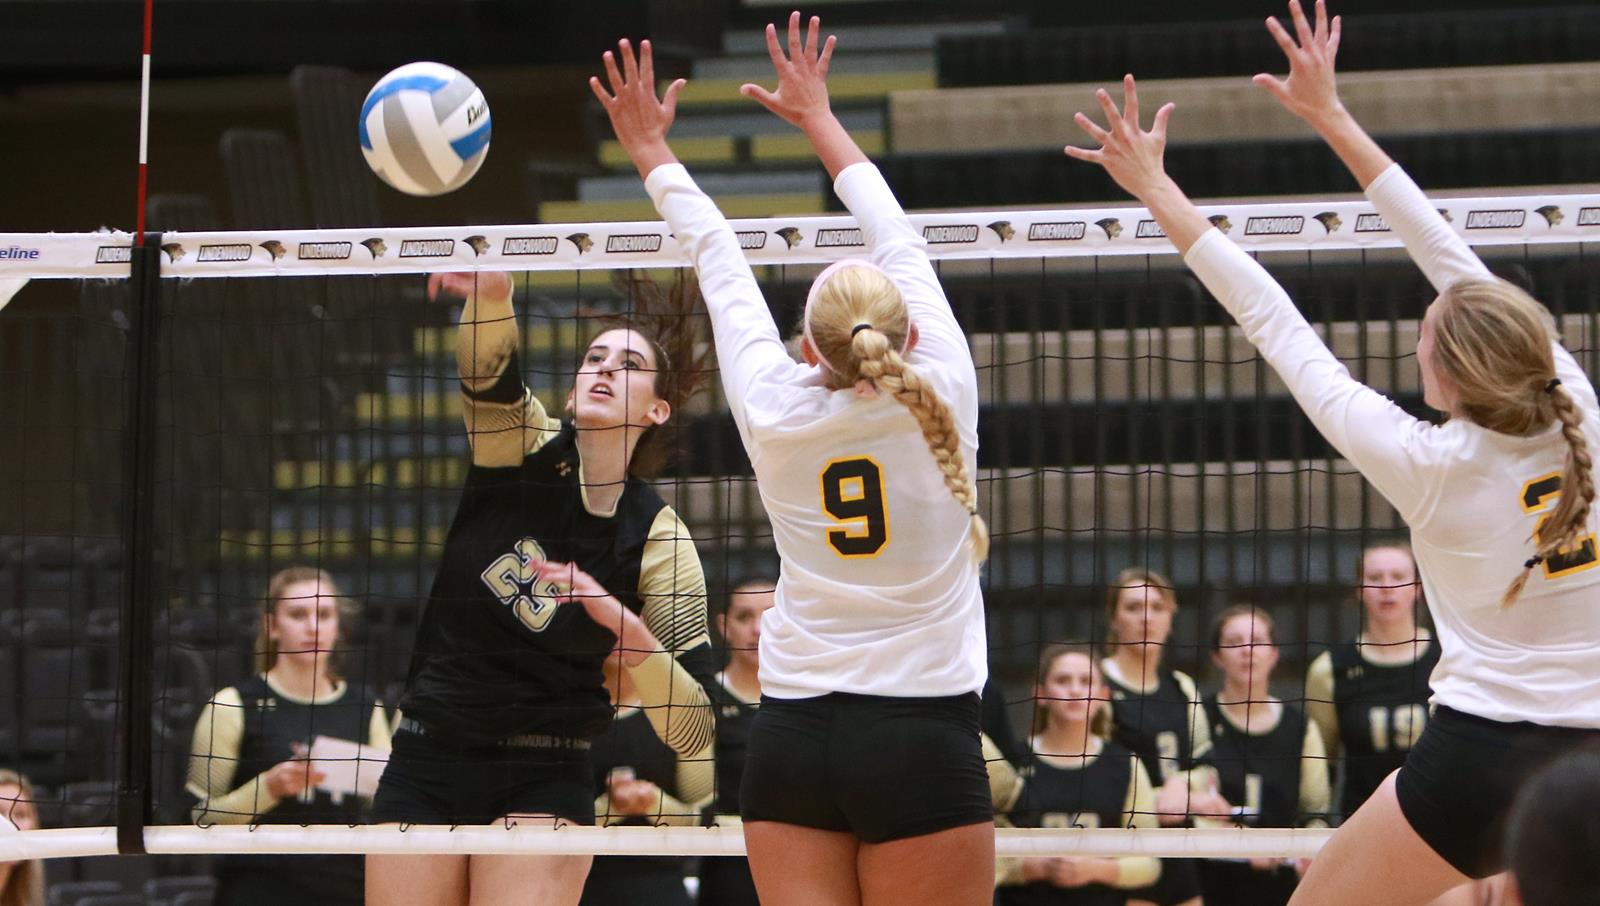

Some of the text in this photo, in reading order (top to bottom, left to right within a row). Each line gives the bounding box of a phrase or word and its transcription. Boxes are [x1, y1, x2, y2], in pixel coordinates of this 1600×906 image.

[1245, 216, 1304, 235] LINDENWOOD
[1466, 209, 1526, 229] LINDENWOOD
[923, 224, 979, 244] LINDENWOOD
[1028, 221, 1086, 241] LINDENWOOD
[197, 244, 252, 262] LINDENWOOD
[298, 242, 352, 259] LINDENWOOD
[399, 239, 454, 257] LINDENWOOD
[502, 237, 558, 255] LINDENWOOD
[606, 234, 662, 253] LINDENWOOD
[96, 246, 132, 264] LINDEN
[818, 454, 890, 559] 9
[1519, 470, 1600, 580] 2
